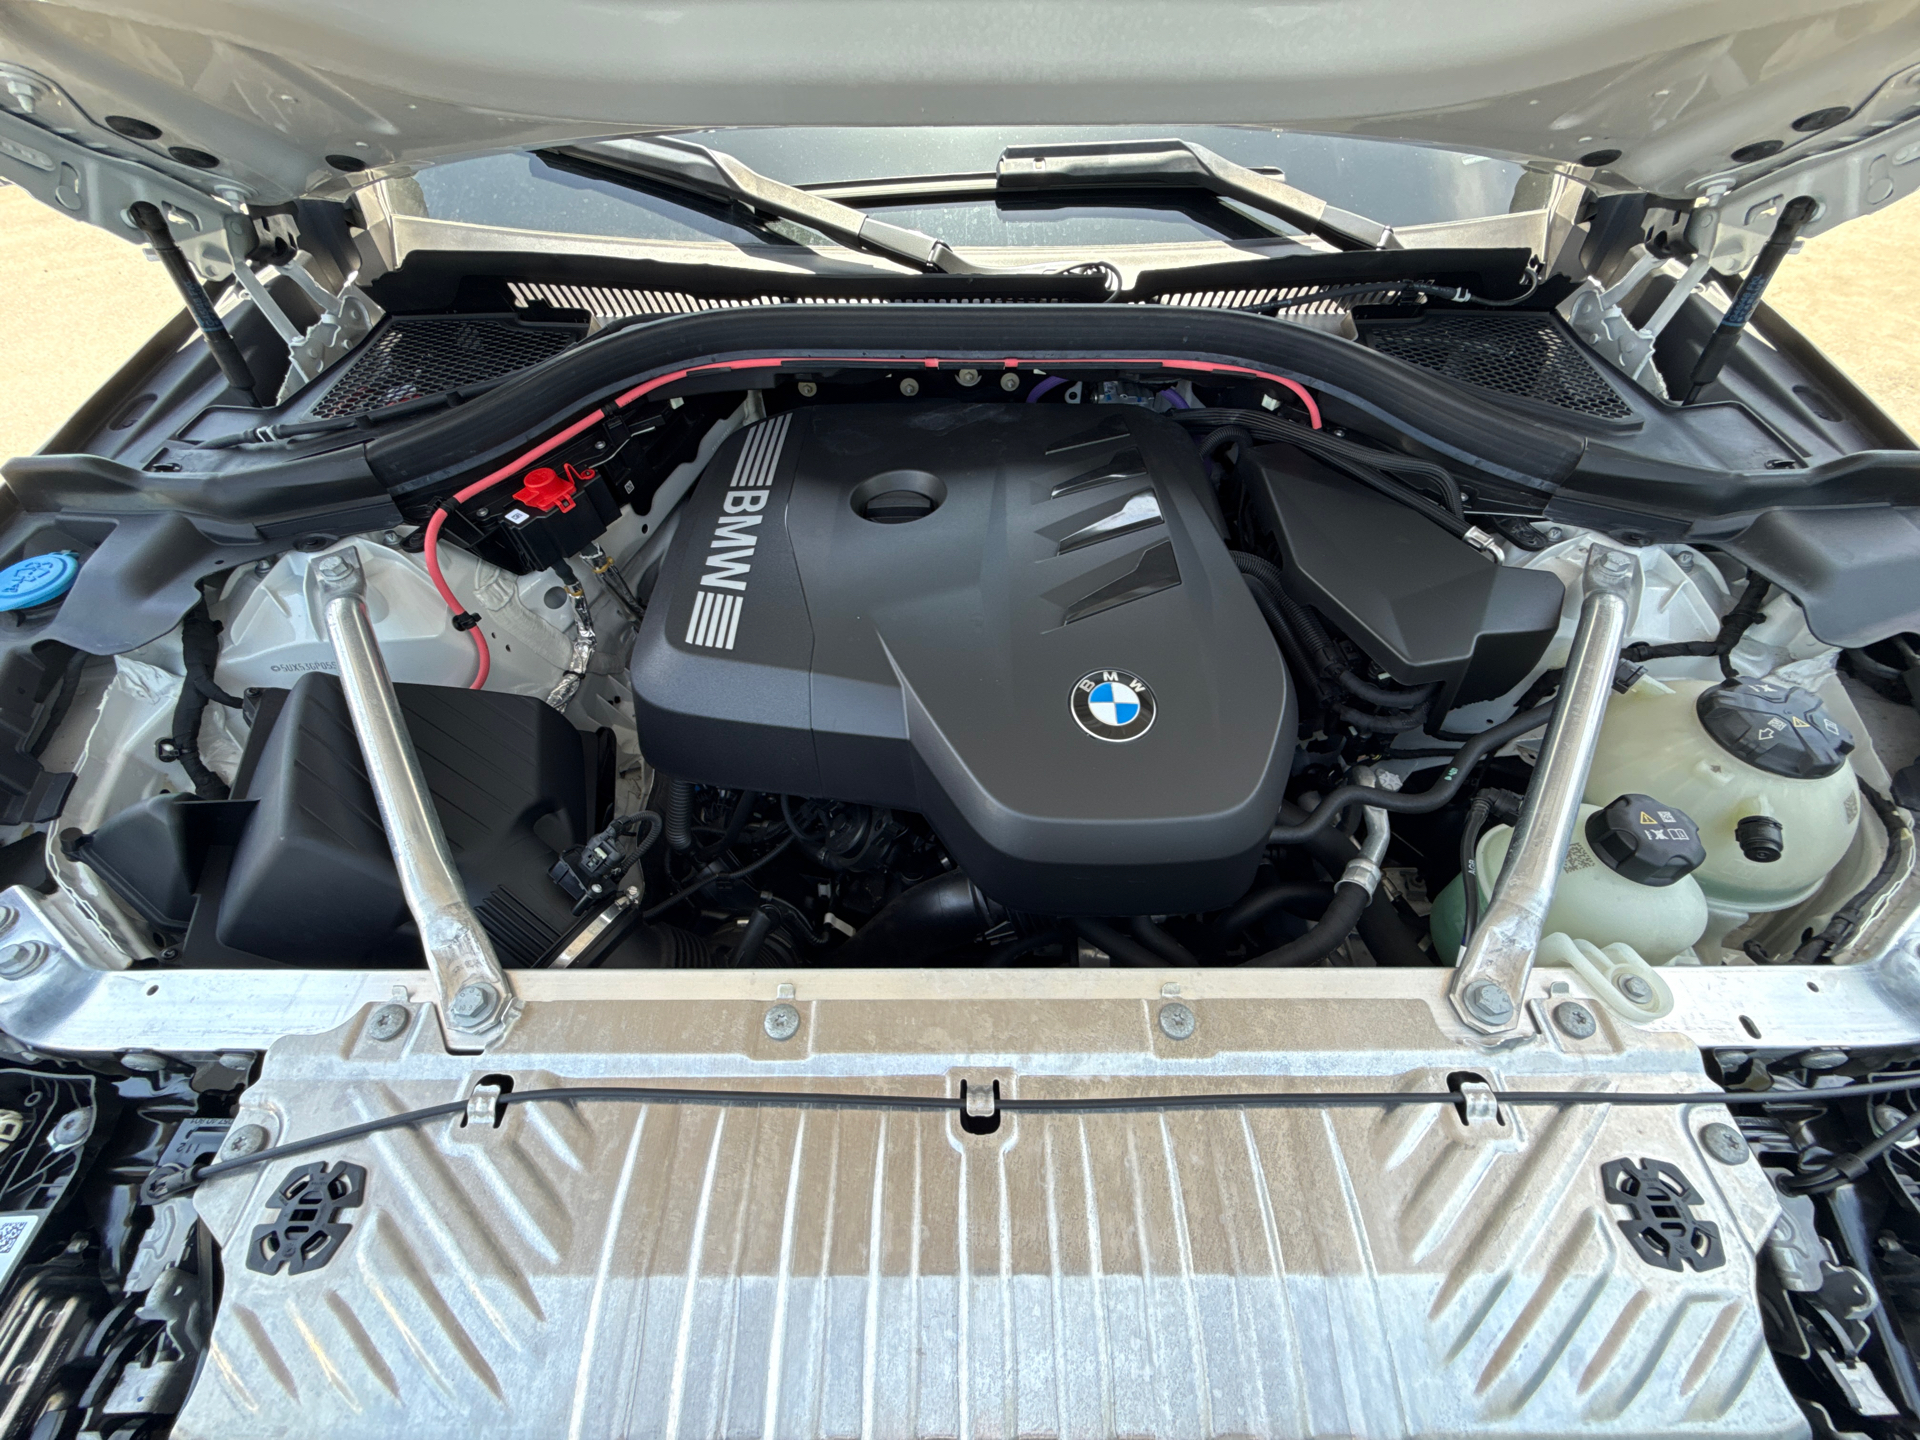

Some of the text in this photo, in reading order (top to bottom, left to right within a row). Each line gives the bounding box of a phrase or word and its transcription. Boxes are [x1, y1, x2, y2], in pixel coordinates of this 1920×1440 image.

[699, 489, 771, 591] BMW
[1079, 671, 1146, 693] BMW
[176, 1142, 200, 1154] 112
